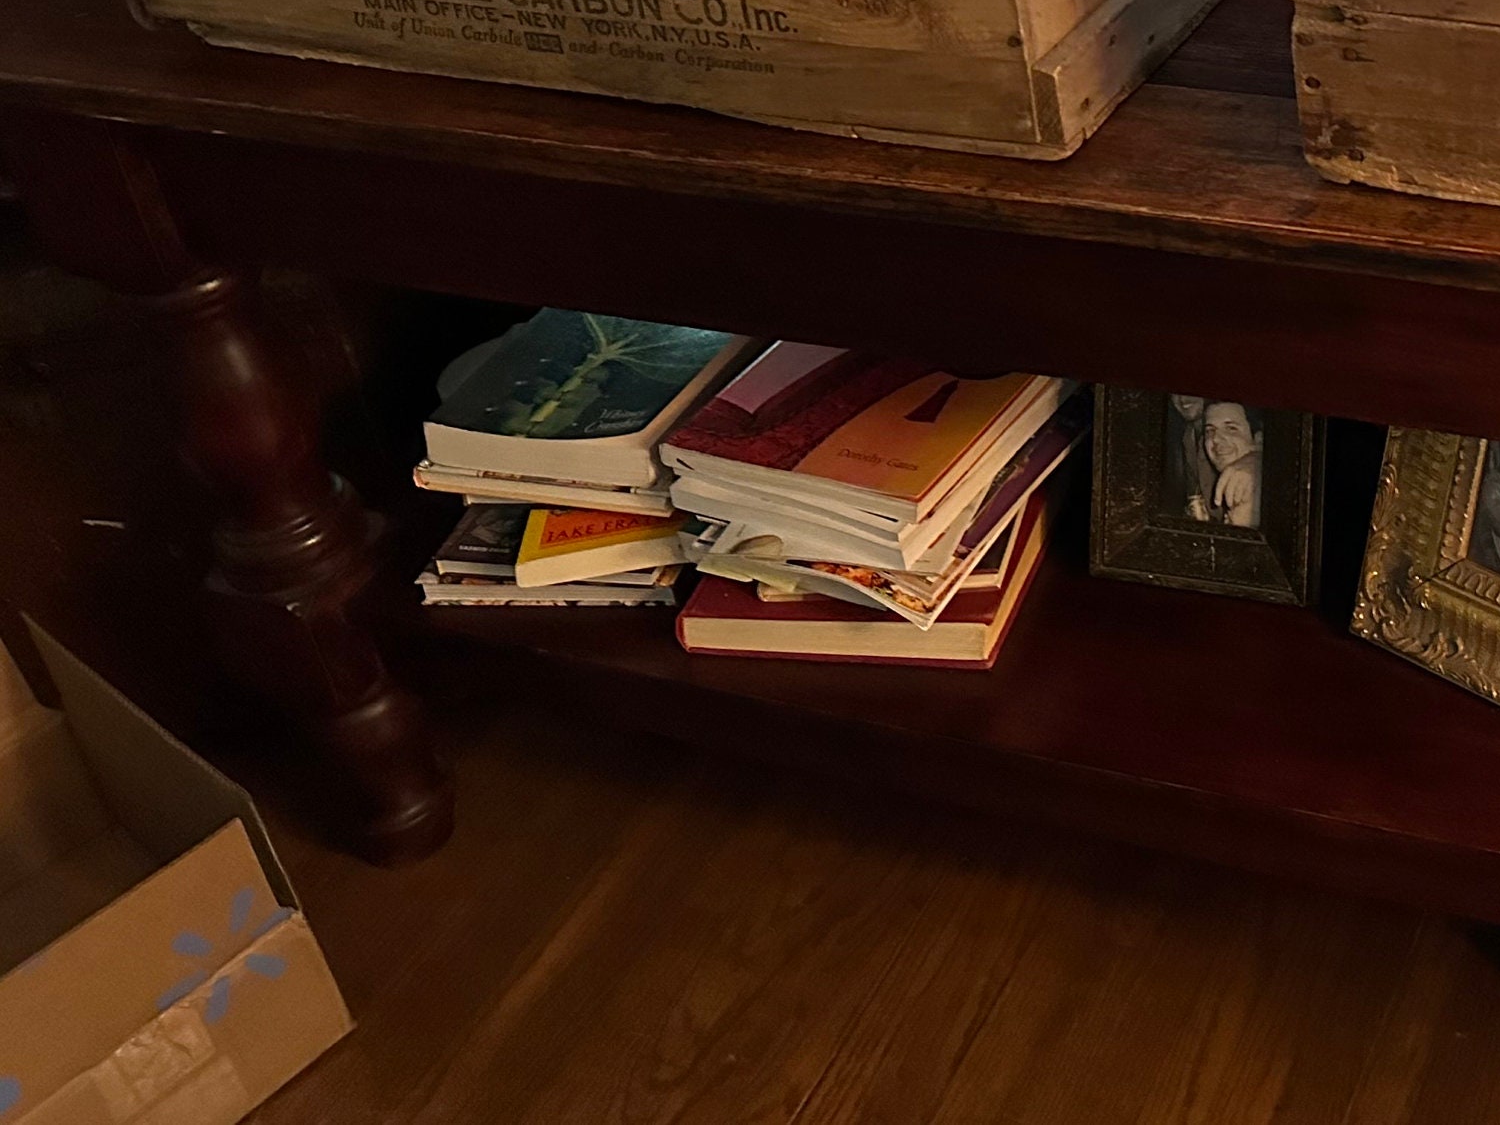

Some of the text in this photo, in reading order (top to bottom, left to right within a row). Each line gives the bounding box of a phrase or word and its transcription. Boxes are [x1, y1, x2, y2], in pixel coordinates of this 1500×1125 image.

[353, 11, 386, 30] Unit
[391, 17, 407, 38] of
[412, 18, 456, 38] Union
[609, 41, 665, 62] Carbon
[675, 49, 775, 74] Corporation
